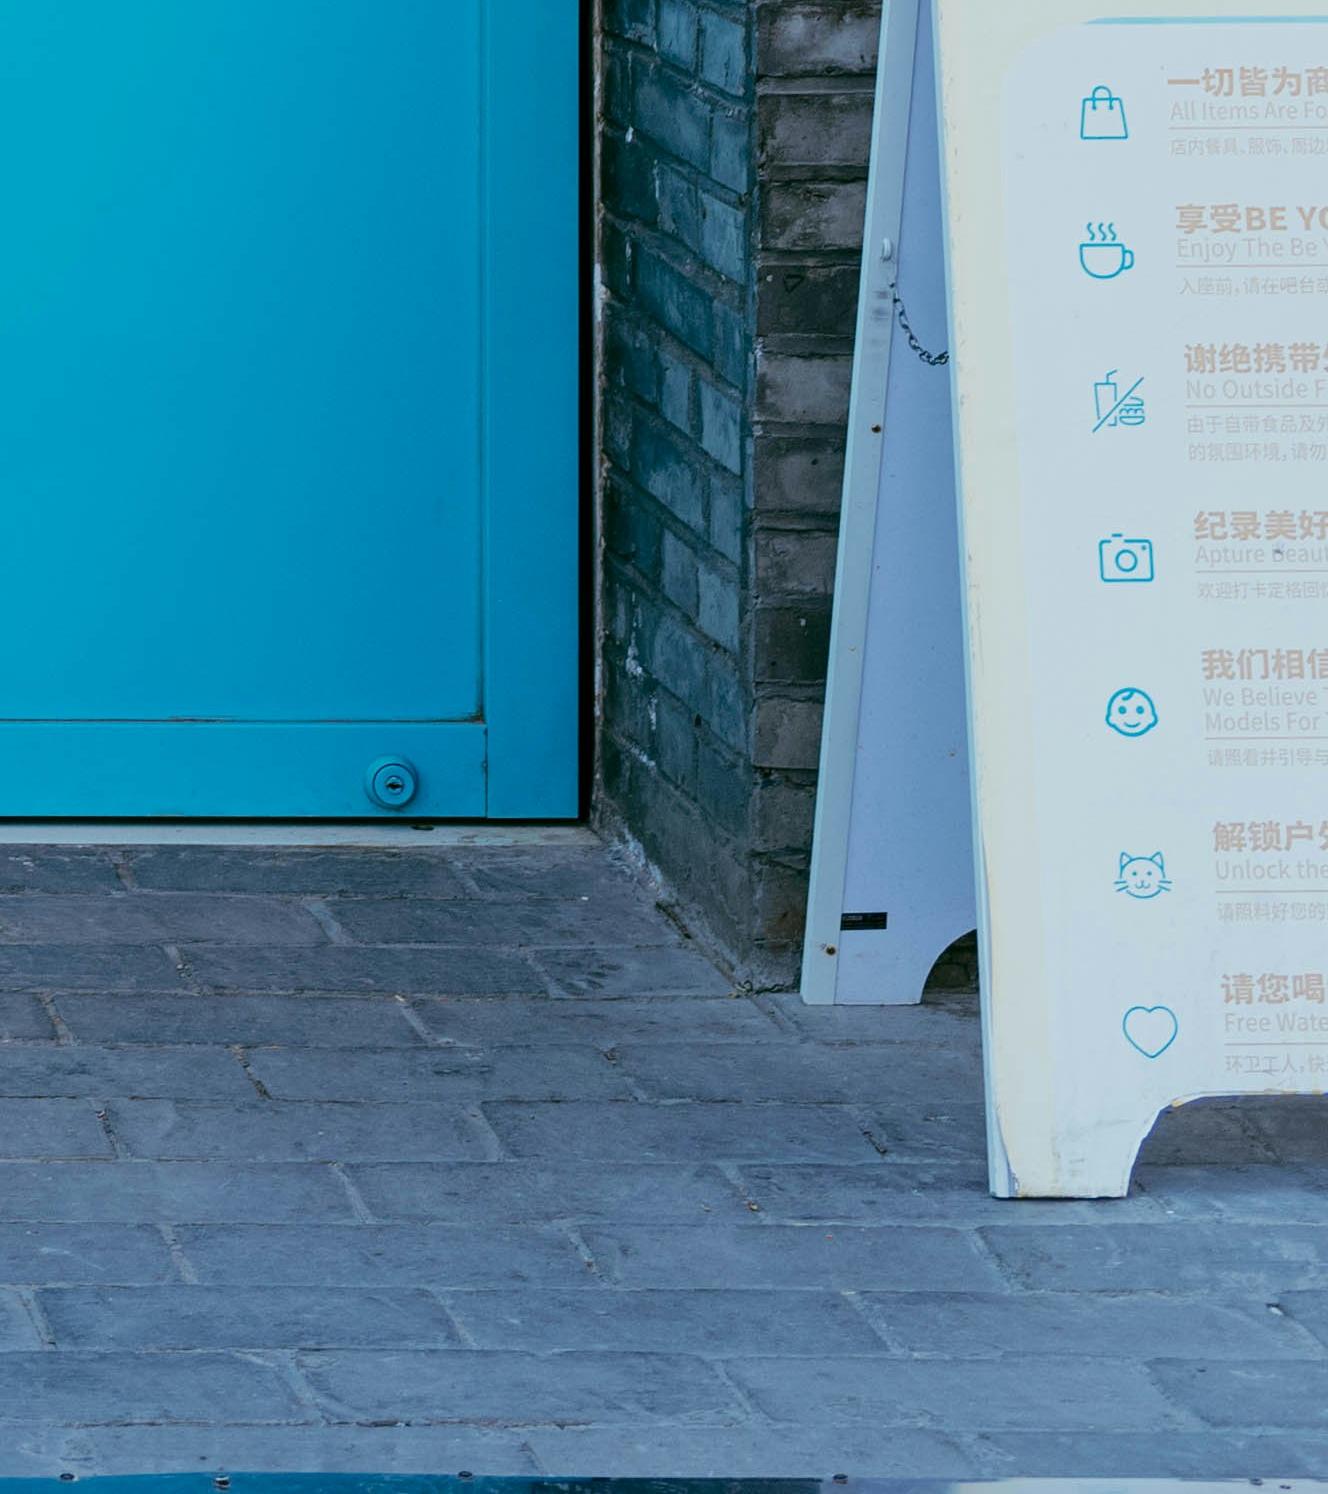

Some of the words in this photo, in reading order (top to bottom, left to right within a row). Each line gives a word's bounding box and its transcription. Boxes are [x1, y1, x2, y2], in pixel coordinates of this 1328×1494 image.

[1169, 101, 1195, 120] All
[1202, 101, 1258, 120] Items
[1265, 101, 1298, 120] Are
[1176, 237, 1237, 263] Enjoy
[1242, 237, 1284, 258] The
[1290, 237, 1319, 257] Be
[1185, 379, 1217, 399] No
[1222, 377, 1309, 399] Outside
[1194, 545, 1265, 568] Apture
[1202, 687, 1235, 707] We
[1241, 685, 1318, 707] Believe
[1205, 711, 1281, 732] Models
[1287, 711, 1321, 731] For
[1215, 858, 1291, 880] Unlock
[1223, 1012, 1272, 1033] Free
